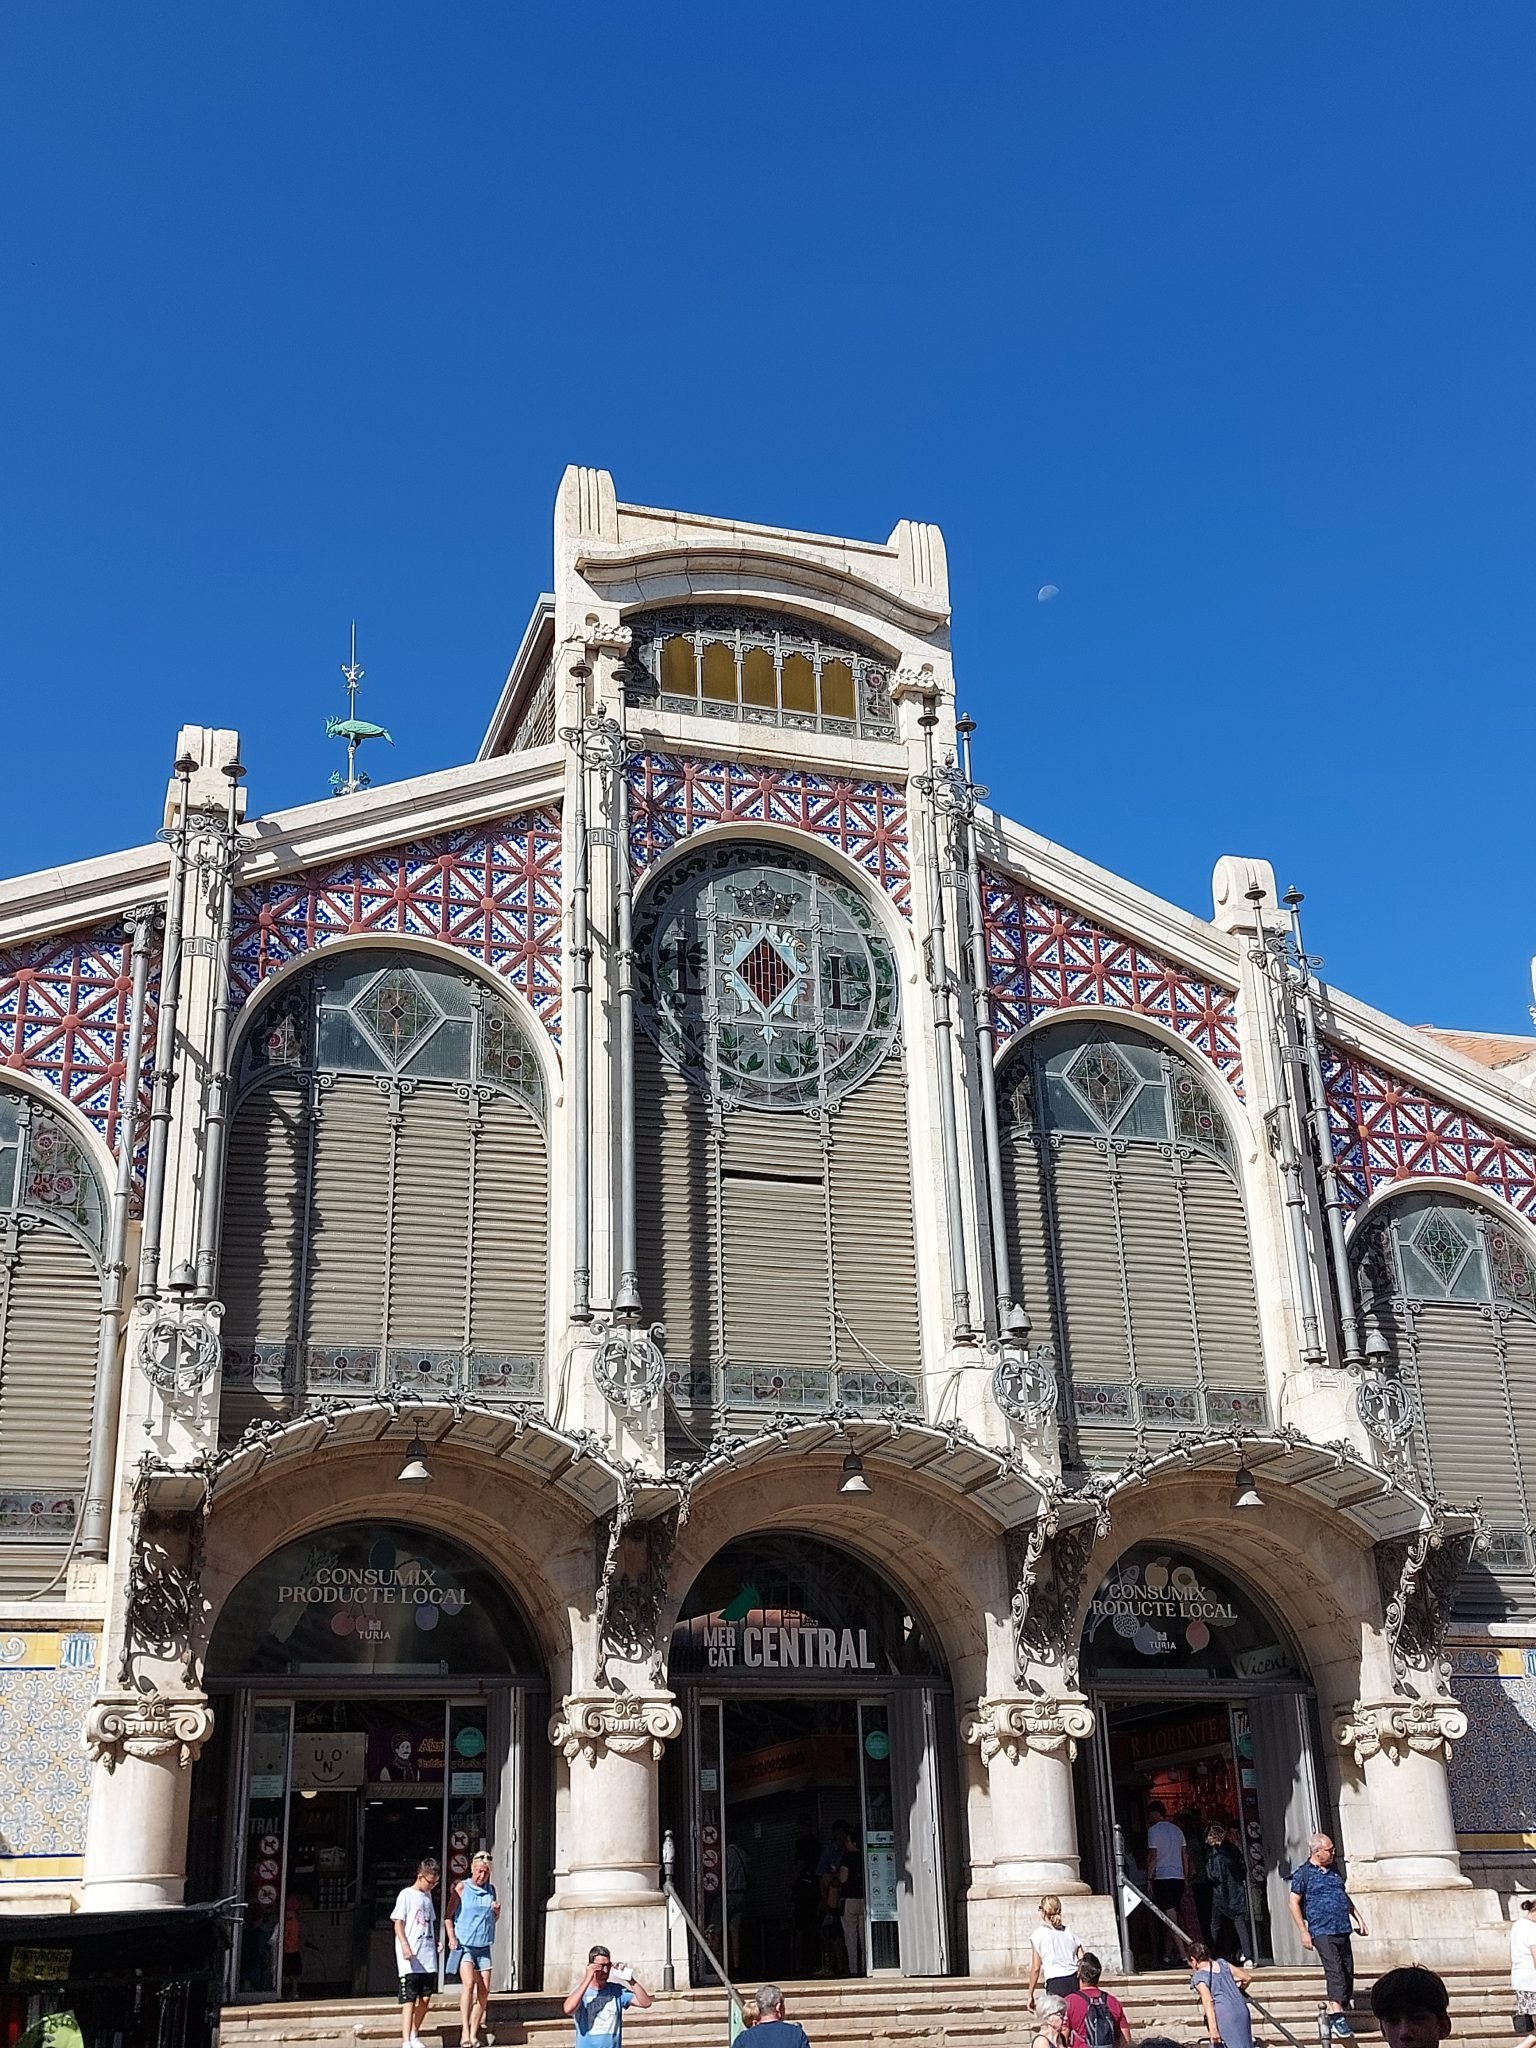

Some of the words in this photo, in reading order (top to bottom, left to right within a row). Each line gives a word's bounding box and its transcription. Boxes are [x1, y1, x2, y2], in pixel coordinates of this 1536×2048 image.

[316, 1568, 436, 1586] CONSUMIX
[278, 1586, 395, 1604] PRODUCTE
[401, 1587, 472, 1605] LOCAL
[1109, 1584, 1207, 1601] CONSUMIX
[1088, 1600, 1176, 1618] RODUCTE
[1180, 1603, 1238, 1619] LOCAL
[359, 1631, 391, 1640] TURIA
[703, 1626, 736, 1647] MER
[1149, 1640, 1177, 1650] TURIA
[708, 1647, 736, 1667] CAT
[743, 1627, 876, 1669] CENTRAL
[1239, 1651, 1288, 1676] Vicent
[1146, 1718, 1219, 1757] LORENTE
